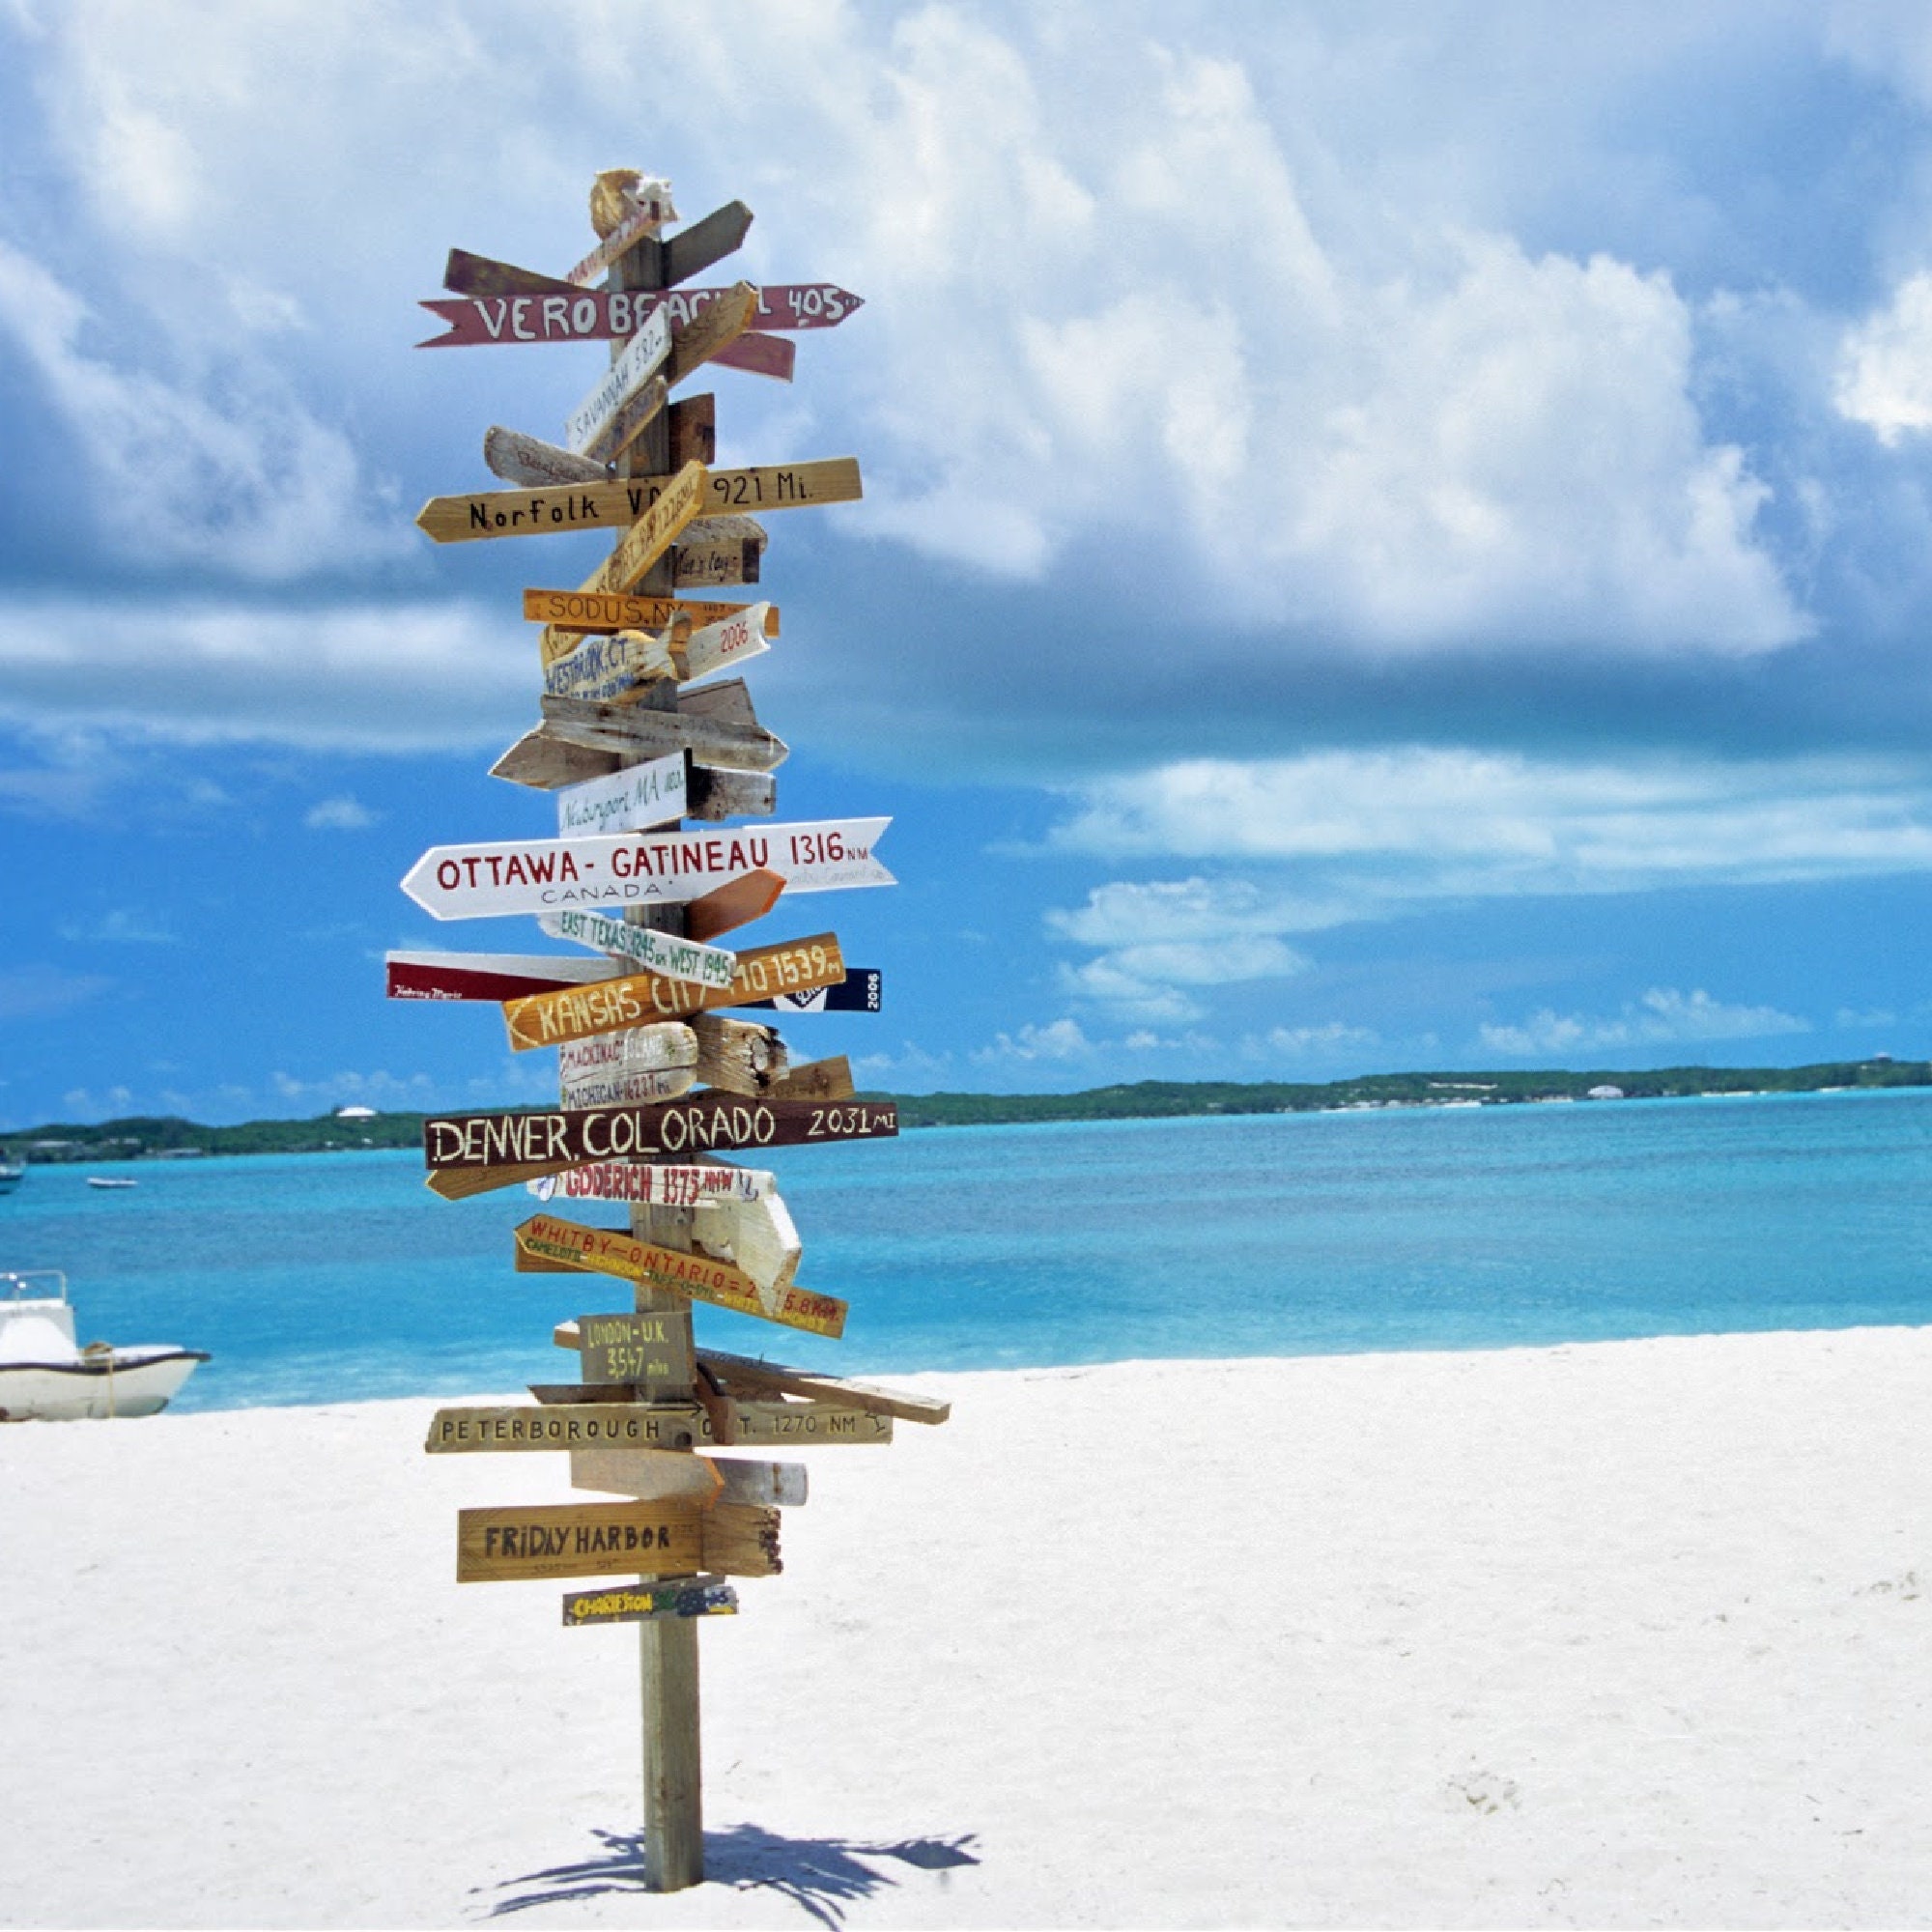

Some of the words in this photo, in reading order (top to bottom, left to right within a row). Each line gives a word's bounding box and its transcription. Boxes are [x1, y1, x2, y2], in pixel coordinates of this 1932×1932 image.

[473, 297, 596, 339] VERO
[609, 292, 721, 334] BEAC
[787, 288, 844, 320] 405
[469, 495, 599, 529] Norfolk
[713, 475, 762, 505] 921
[720, 620, 749, 654] 2006
[611, 838, 769, 877] GATINEAU
[789, 832, 844, 866] 1316
[542, 883, 662, 903] CANADA
[537, 981, 641, 1041] KANSAS
[773, 945, 827, 986] 1539
[807, 1107, 872, 1137] 2031
[566, 1163, 653, 1202] GODERICH
[441, 1419, 660, 1442] PETERBOROUGH
[774, 1415, 817, 1435] 1270
[829, 1415, 856, 1435] NM
[575, 1524, 670, 1554] HARBOR
